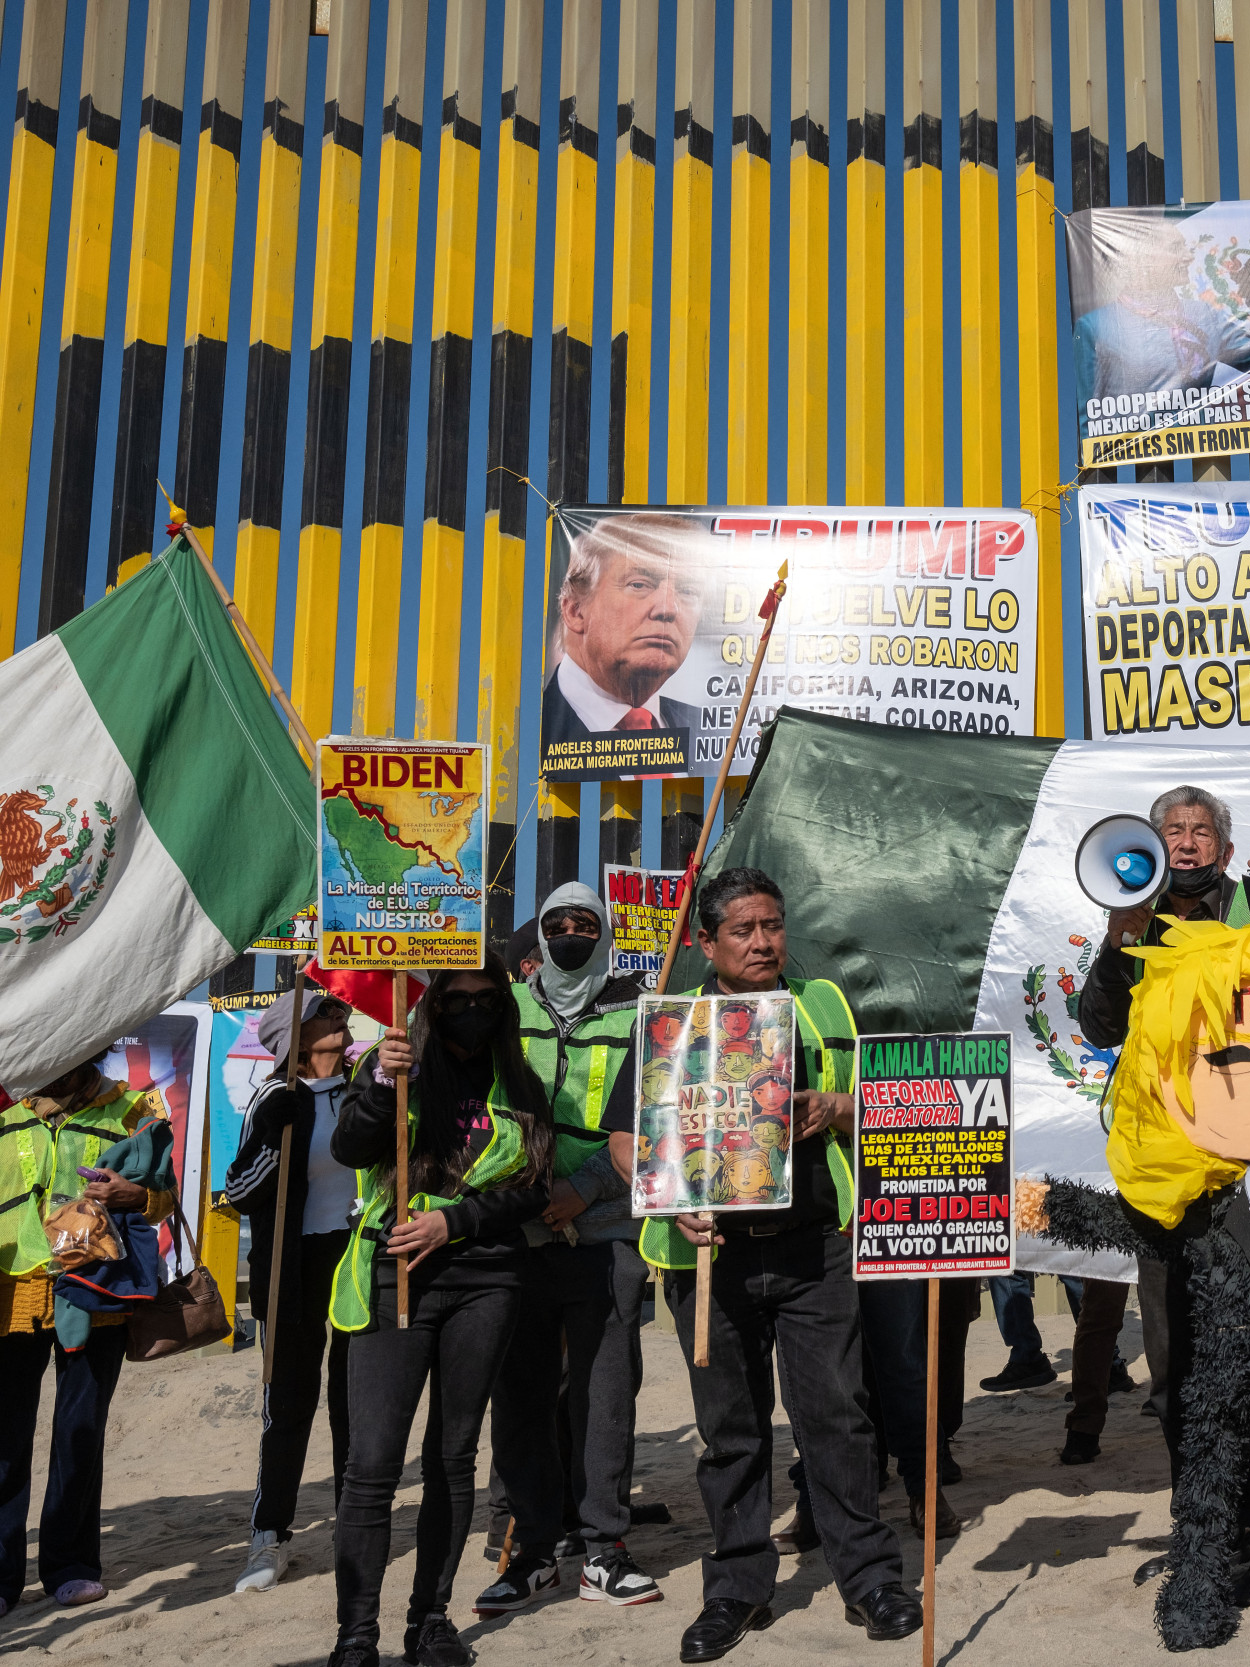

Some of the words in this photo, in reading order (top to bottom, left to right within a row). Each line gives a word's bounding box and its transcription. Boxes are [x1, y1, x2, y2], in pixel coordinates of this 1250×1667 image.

[1087, 384, 1238, 419] COOPERACION
[1088, 413, 1150, 437] MEXICO
[1155, 412, 1173, 428] ES
[1178, 409, 1201, 426] UN
[1204, 404, 1242, 424] PAIS
[1095, 553, 1220, 608] ALTO
[964, 588, 1019, 632] LO
[721, 635, 786, 666] QUE
[796, 636, 861, 664] NOS
[870, 636, 1018, 673] ROBARON
[890, 677, 1020, 710] ARIZONA,
[547, 741, 592, 756] ANGELES
[614, 737, 674, 752] FRONTERAS
[343, 755, 463, 788] BIDEN
[542, 757, 584, 771] ALIANZA
[586, 754, 638, 769] MIGRANTE
[641, 751, 685, 766] TIJUANA
[347, 882, 386, 897] Mitad
[388, 882, 408, 897] del
[411, 882, 476, 897] Territorio
[608, 872, 643, 905] NO
[416, 900, 430, 910] es
[356, 912, 446, 930] NUESTRO
[328, 936, 398, 957] ALTO
[408, 937, 477, 950] Deportaciones
[408, 947, 421, 957] de
[424, 946, 477, 956] Mexicanos
[328, 957, 337, 966] de
[339, 957, 349, 965] los
[351, 957, 390, 967] Territorios
[392, 958, 405, 969] que
[421, 957, 444, 967] fueron
[447, 957, 477, 966] Robados
[861, 1041, 934, 1078] KAMALA
[940, 1040, 1009, 1076] HARRIS
[678, 1086, 751, 1110] NADIE
[860, 1079, 959, 1107] REFORMA
[953, 1079, 1009, 1127] YA
[680, 1113, 698, 1130] ES
[861, 1107, 961, 1129] MIGRATORIA
[959, 1132, 977, 1143] DE
[980, 1130, 1006, 1141] LOS
[863, 1145, 892, 1156] MAS
[895, 1144, 913, 1155] DE
[917, 1143, 932, 1154] 11
[935, 1142, 1003, 1153] MILLONES
[864, 1156, 889, 1167] DE
[894, 1153, 1003, 1166] MEXICANOS
[881, 1167, 899, 1177] EN
[902, 1166, 927, 1177] LOS
[880, 1179, 956, 1194] PROMETIDA
[959, 1178, 987, 1192] POR
[859, 1198, 912, 1223] JOE
[920, 1195, 1009, 1221] BIDEN
[863, 1225, 903, 1239] QUIEN
[906, 1219, 943, 1236] GANÓ
[946, 1221, 1004, 1236] GRACIAS
[858, 1239, 882, 1257] AL
[887, 1238, 937, 1256] VOTO
[941, 1235, 1009, 1254] LATINO
